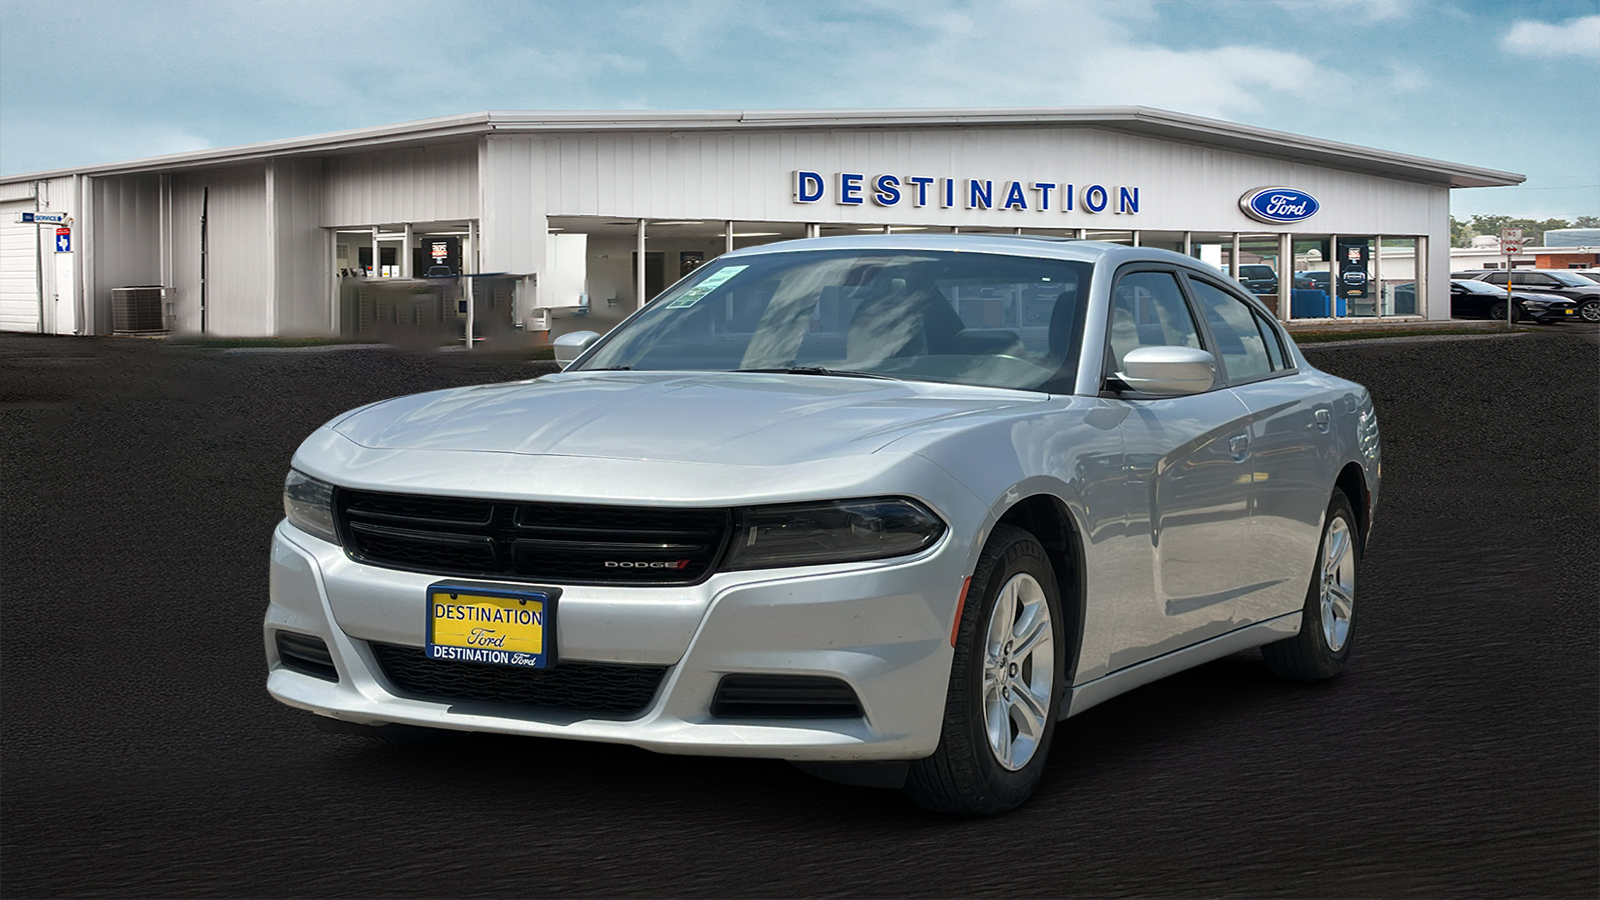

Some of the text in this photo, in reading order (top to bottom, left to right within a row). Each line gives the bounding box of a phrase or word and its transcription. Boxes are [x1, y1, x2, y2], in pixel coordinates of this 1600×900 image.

[793, 170, 1141, 214] DESTINATION
[1266, 194, 1307, 216] Ford
[435, 604, 542, 626] DESTINATION
[467, 627, 505, 647] Ford
[434, 645, 536, 666] DESTINATION Ford
